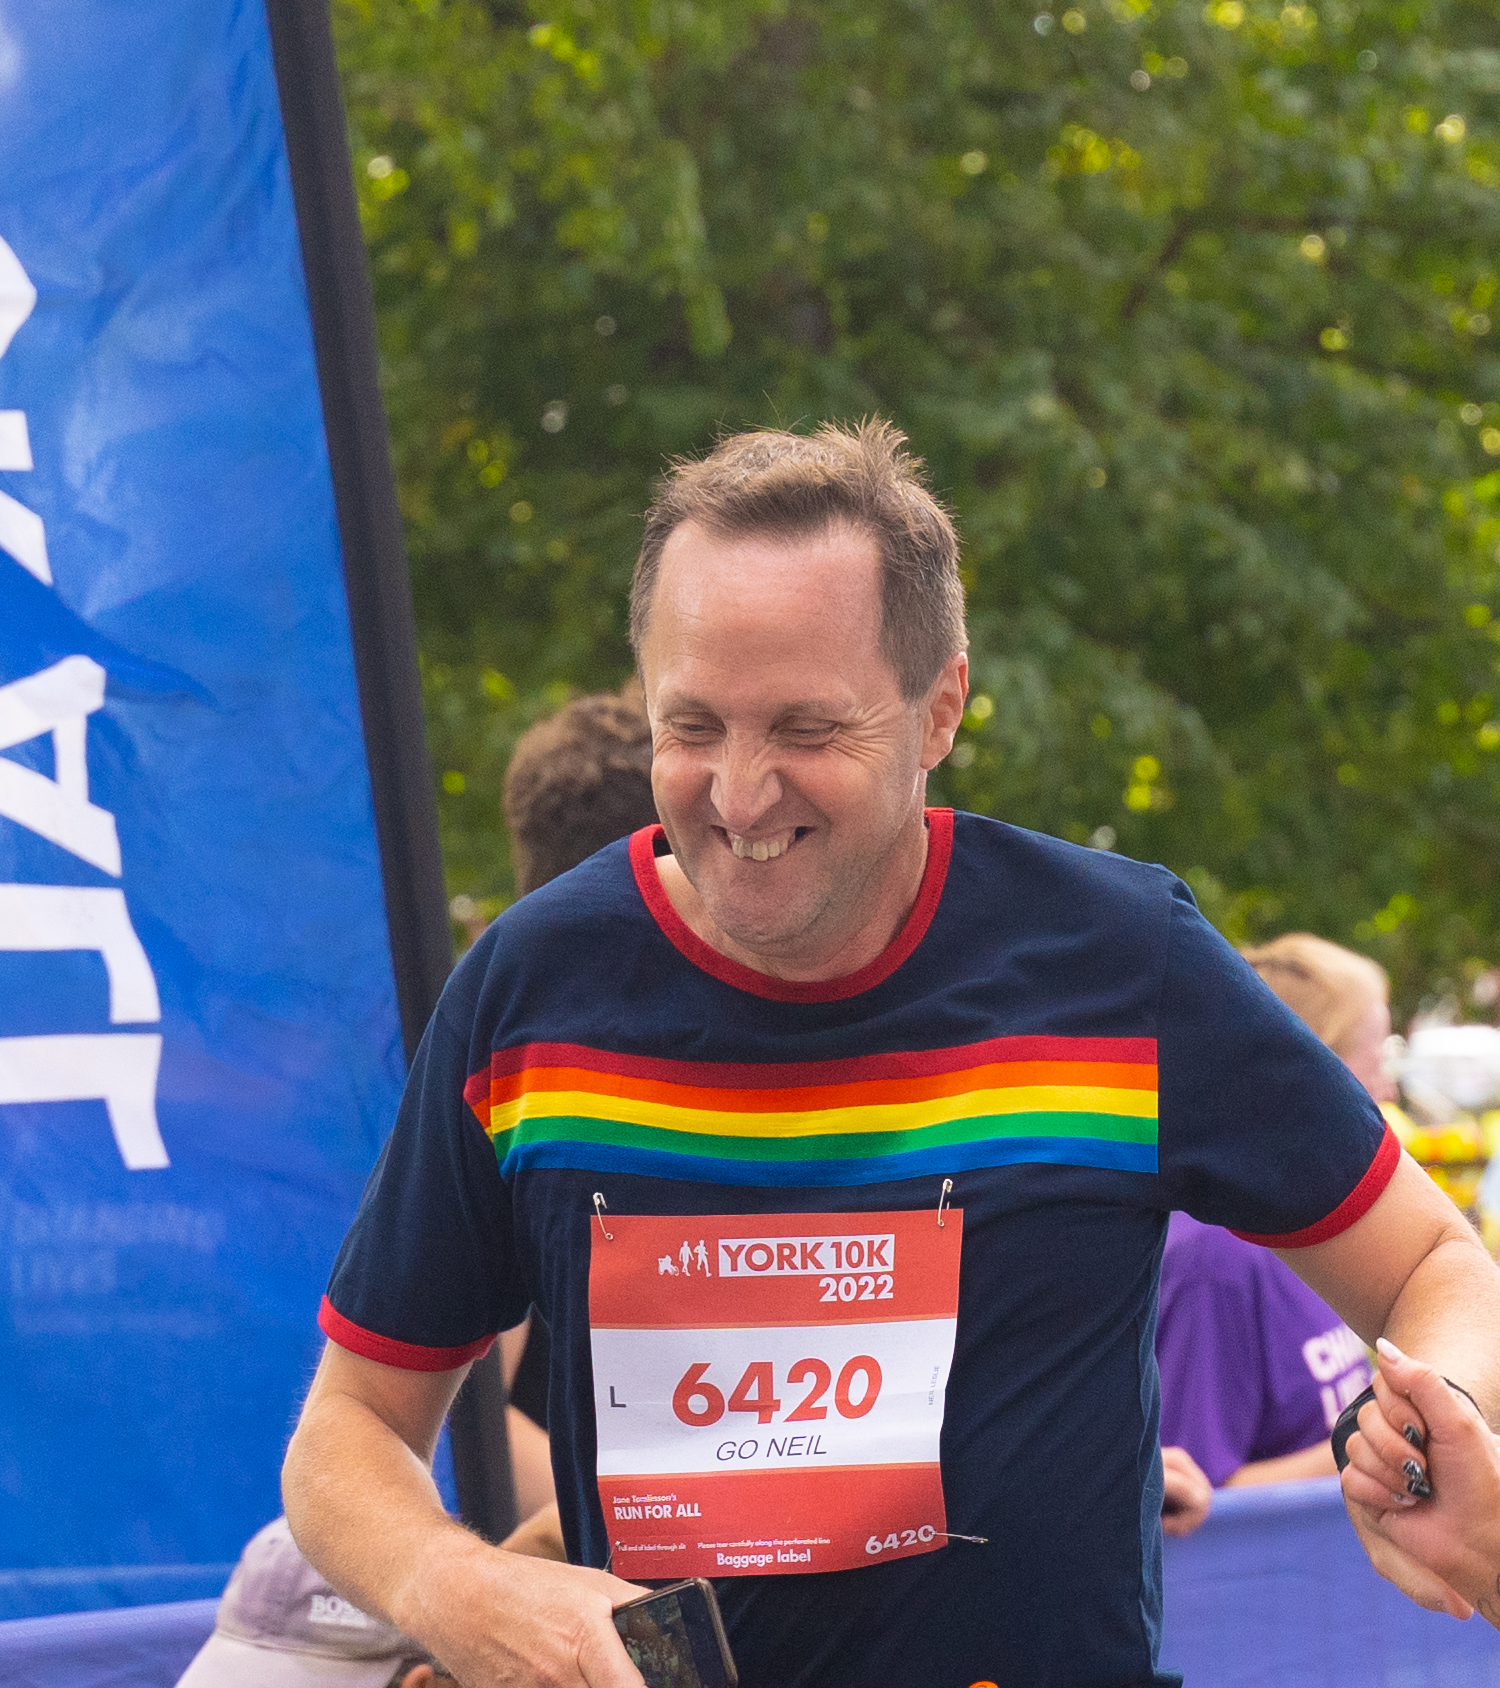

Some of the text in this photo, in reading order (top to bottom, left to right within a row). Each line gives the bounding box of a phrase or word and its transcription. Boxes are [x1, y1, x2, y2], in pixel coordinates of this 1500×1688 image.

[720, 1237, 892, 1273] YORK 10K
[819, 1274, 894, 1303] 2022
[609, 1385, 627, 1409] L
[671, 1354, 883, 1428] 6420
[715, 1434, 828, 1462] GO NEIL
[613, 1502, 702, 1520] RUN FOR ALL
[865, 1524, 936, 1555] 6420
[716, 1548, 811, 1568] Baggage label
